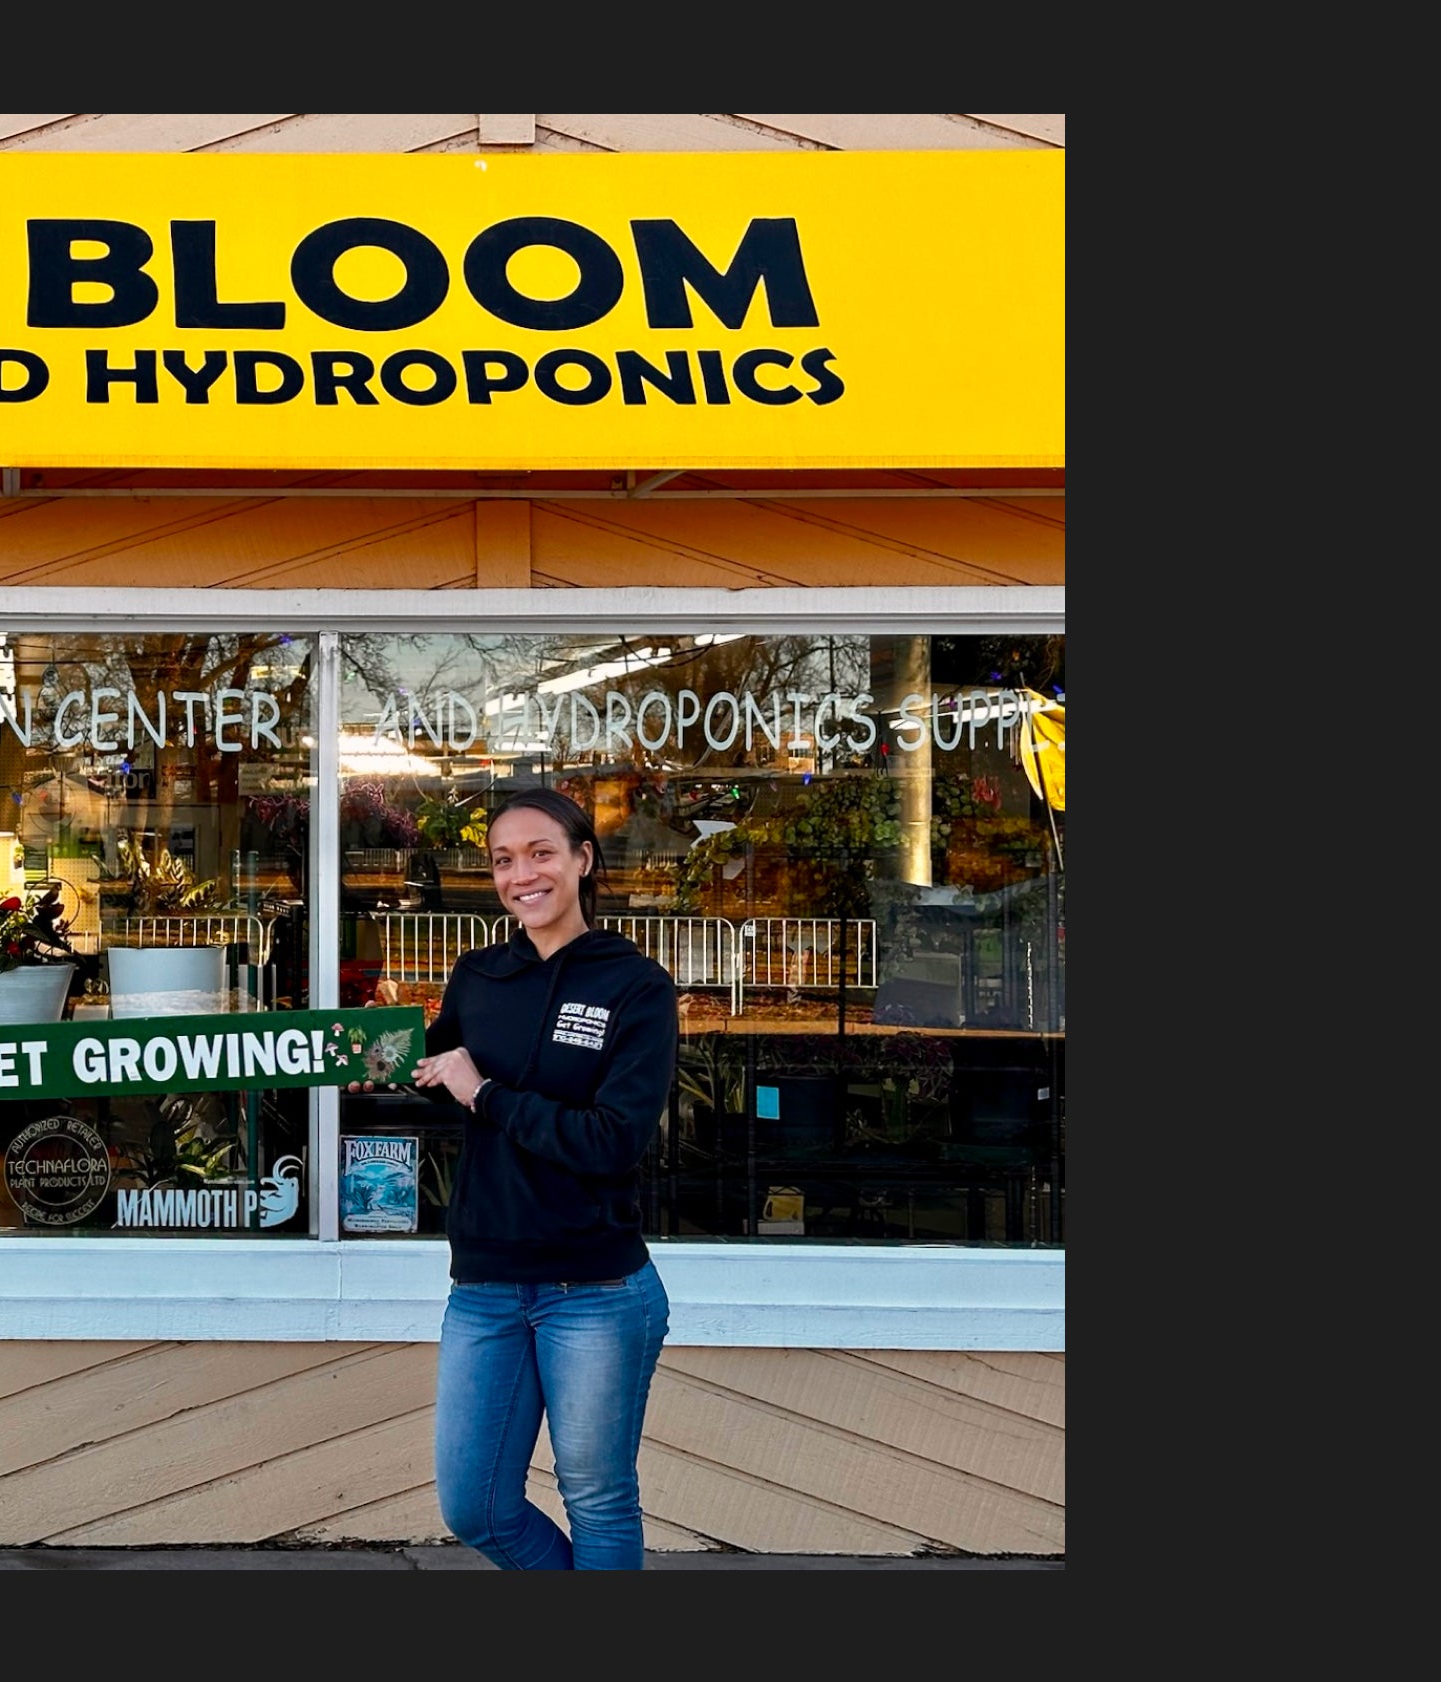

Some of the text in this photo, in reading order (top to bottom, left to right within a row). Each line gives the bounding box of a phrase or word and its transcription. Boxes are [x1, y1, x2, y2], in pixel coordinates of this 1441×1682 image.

[26, 216, 821, 332] BLOOM
[85, 347, 847, 407] HYDROPONICS
[54, 687, 283, 753] CENTER
[374, 690, 478, 751] AND
[496, 689, 878, 752] HYDROPONICS
[896, 690, 1065, 752] SUPPL
[560, 1002, 610, 1021] DESERT BLOOM
[72, 1028, 325, 1083] GROWING!
[10, 1118, 102, 1154] AUTHORIZED RETAILER
[7, 1158, 107, 1175] TECHNAFLORA
[10, 1175, 106, 1188] PLANT PRODUCTS LTD
[117, 1188, 258, 1228] MAMMOTH P
